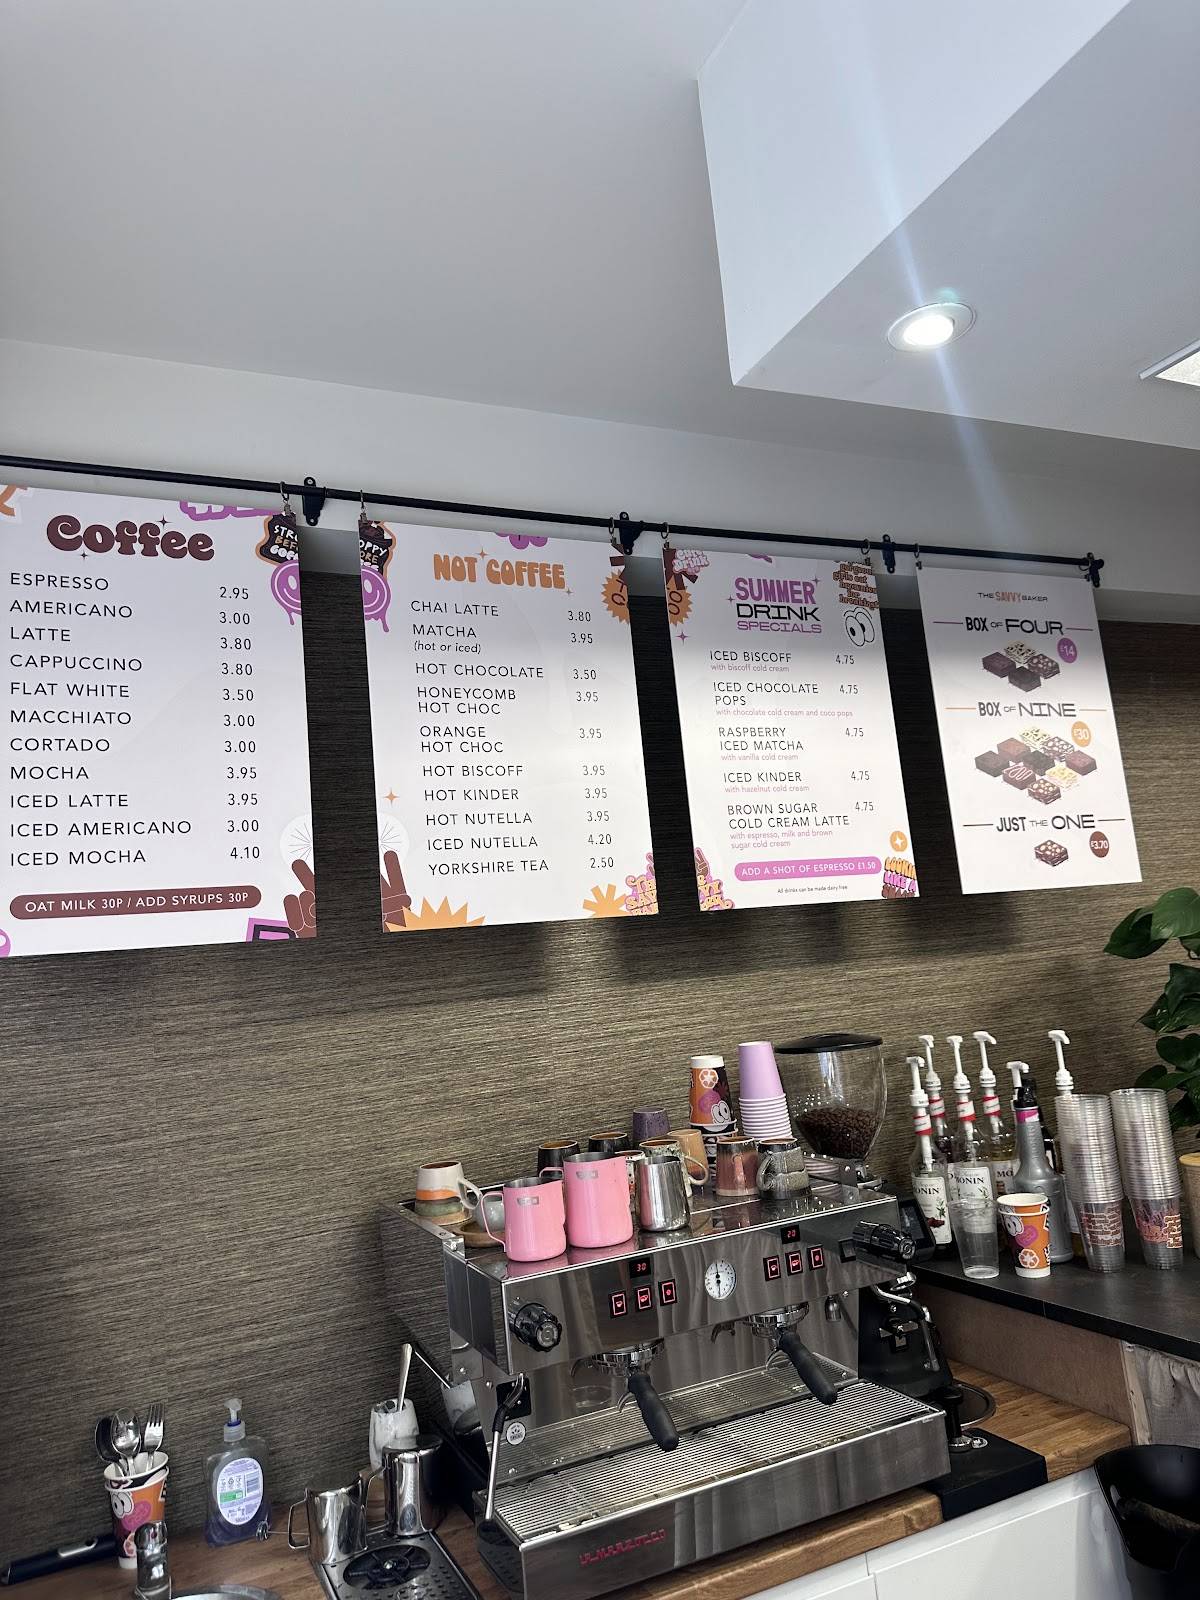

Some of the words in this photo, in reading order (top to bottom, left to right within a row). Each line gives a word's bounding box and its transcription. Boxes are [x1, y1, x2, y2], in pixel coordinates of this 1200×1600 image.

[47, 515, 214, 561] Coffee
[433, 554, 479, 582] NOT
[486, 558, 566, 589] COFFEE
[10, 572, 109, 590] ESPRESSO
[220, 586, 249, 599] 2.95
[735, 578, 816, 604] SUMMER
[995, 592, 1021, 602] SAVVY
[10, 601, 133, 618] AMERICANO
[411, 601, 448, 613] CHAI
[455, 603, 499, 617] LATTE
[737, 603, 821, 621] DRINK
[219, 612, 251, 625] 3.00
[568, 610, 591, 622] 3.80
[413, 624, 477, 638] MATCHA
[737, 621, 822, 633] SPECIALS
[965, 617, 988, 631] BOX
[1005, 619, 1063, 635] FOUR
[10, 627, 71, 642] LATTE
[571, 633, 593, 644] 3.95
[220, 638, 251, 650] 3.80
[414, 641, 435, 652] (hot
[440, 643, 451, 652] or
[455, 642, 482, 655] iced)
[10, 655, 142, 671] CAPPUCCINO
[710, 651, 738, 661] ICED
[744, 652, 792, 663] BISCOFF
[836, 655, 855, 664] 4.75
[222, 663, 253, 676] 3.80
[416, 662, 447, 675] HOT
[454, 664, 544, 678] CHOCOLATE
[728, 664, 751, 672] biscoff
[573, 669, 597, 680] 3.50
[10, 682, 57, 696] FLAT
[67, 684, 129, 698] WHITE
[417, 687, 516, 700] HONEYCOMB
[713, 682, 741, 692] ICED
[747, 683, 818, 694] CHOCOLATE
[839, 684, 858, 694] 4.75
[222, 689, 254, 702] 3.50
[576, 691, 599, 703] 3.95
[715, 696, 746, 706] POPS
[418, 702, 450, 714] HOT
[457, 702, 501, 714] CHOC
[978, 702, 1002, 717] BOX
[1004, 706, 1016, 714] OF
[1018, 703, 1077, 717] NINE
[10, 710, 131, 725] MACCHIATO
[224, 715, 255, 727] 3.00
[420, 725, 486, 738] ORANGE
[579, 728, 602, 739] 3.95
[719, 727, 786, 737] RASPBERRY
[845, 728, 864, 737] 4.75
[1073, 728, 1089, 740] £30
[10, 738, 110, 752] CORTADO
[224, 741, 256, 753] 3.00
[421, 741, 453, 753] HOT
[460, 741, 504, 753] CHOC
[720, 741, 748, 750] ICED
[754, 741, 804, 750] MATCHA
[721, 753, 736, 761] with
[738, 753, 759, 761] vanilla
[762, 753, 775, 761] cold
[10, 766, 89, 779] MOCHA
[227, 767, 257, 779] 3.95
[423, 765, 455, 777] HOT
[462, 765, 523, 777] BISCOFF
[582, 765, 605, 776] 3.95
[851, 772, 869, 780] 4.75
[724, 773, 752, 783] ICED
[757, 772, 802, 782] KINDER
[425, 789, 456, 801] HOT
[464, 789, 519, 801] KINDER
[584, 788, 608, 799] 3.95
[742, 785, 770, 793] hazelnut
[10, 795, 58, 808] ICED
[68, 794, 128, 807] LATTE
[228, 793, 258, 806] 3.95
[728, 804, 773, 815] BROWN
[778, 803, 818, 814] SUGAR
[855, 802, 874, 811] 4.75
[426, 814, 458, 825] HOT
[465, 813, 532, 825] NUTELLA
[587, 811, 610, 822] 3.95
[729, 819, 762, 829] COLD
[768, 817, 810, 828] CREAM
[815, 815, 849, 826] LATTE
[10, 823, 58, 837] ICED
[68, 821, 192, 836] AMERICANO
[227, 819, 259, 832] 3.00
[997, 817, 1026, 832] JUST
[1051, 814, 1096, 830] ONE
[587, 834, 612, 845] 4.20
[730, 832, 745, 840] with
[748, 832, 780, 840] espresso,
[782, 830, 795, 838] milk
[812, 829, 832, 837] brown
[428, 838, 464, 851] ICED
[471, 836, 538, 849] NUTELLA
[731, 842, 751, 850] sugar
[753, 840, 767, 848] cold
[769, 840, 790, 848] cream
[1091, 839, 1109, 850] £3.70
[10, 852, 59, 866] ICED
[69, 850, 146, 865] MOCHA
[230, 846, 260, 859] 4.10
[428, 861, 515, 876] YORKSHIRE
[520, 860, 549, 871] TEA
[590, 857, 614, 869] 2.50
[742, 868, 760, 876] ADD
[764, 867, 770, 875] A
[773, 865, 795, 874] SHOT
[800, 864, 810, 872] OF
[814, 863, 855, 872] ESPRESSO
[857, 861, 875, 870] £1.50
[25, 901, 55, 913] OAT
[61, 899, 96, 911] MILK
[101, 898, 123, 909] 30P
[127, 897, 132, 908] /
[136, 896, 166, 908] ADD
[172, 893, 223, 906] SYRUPS
[228, 892, 249, 903] 30P
